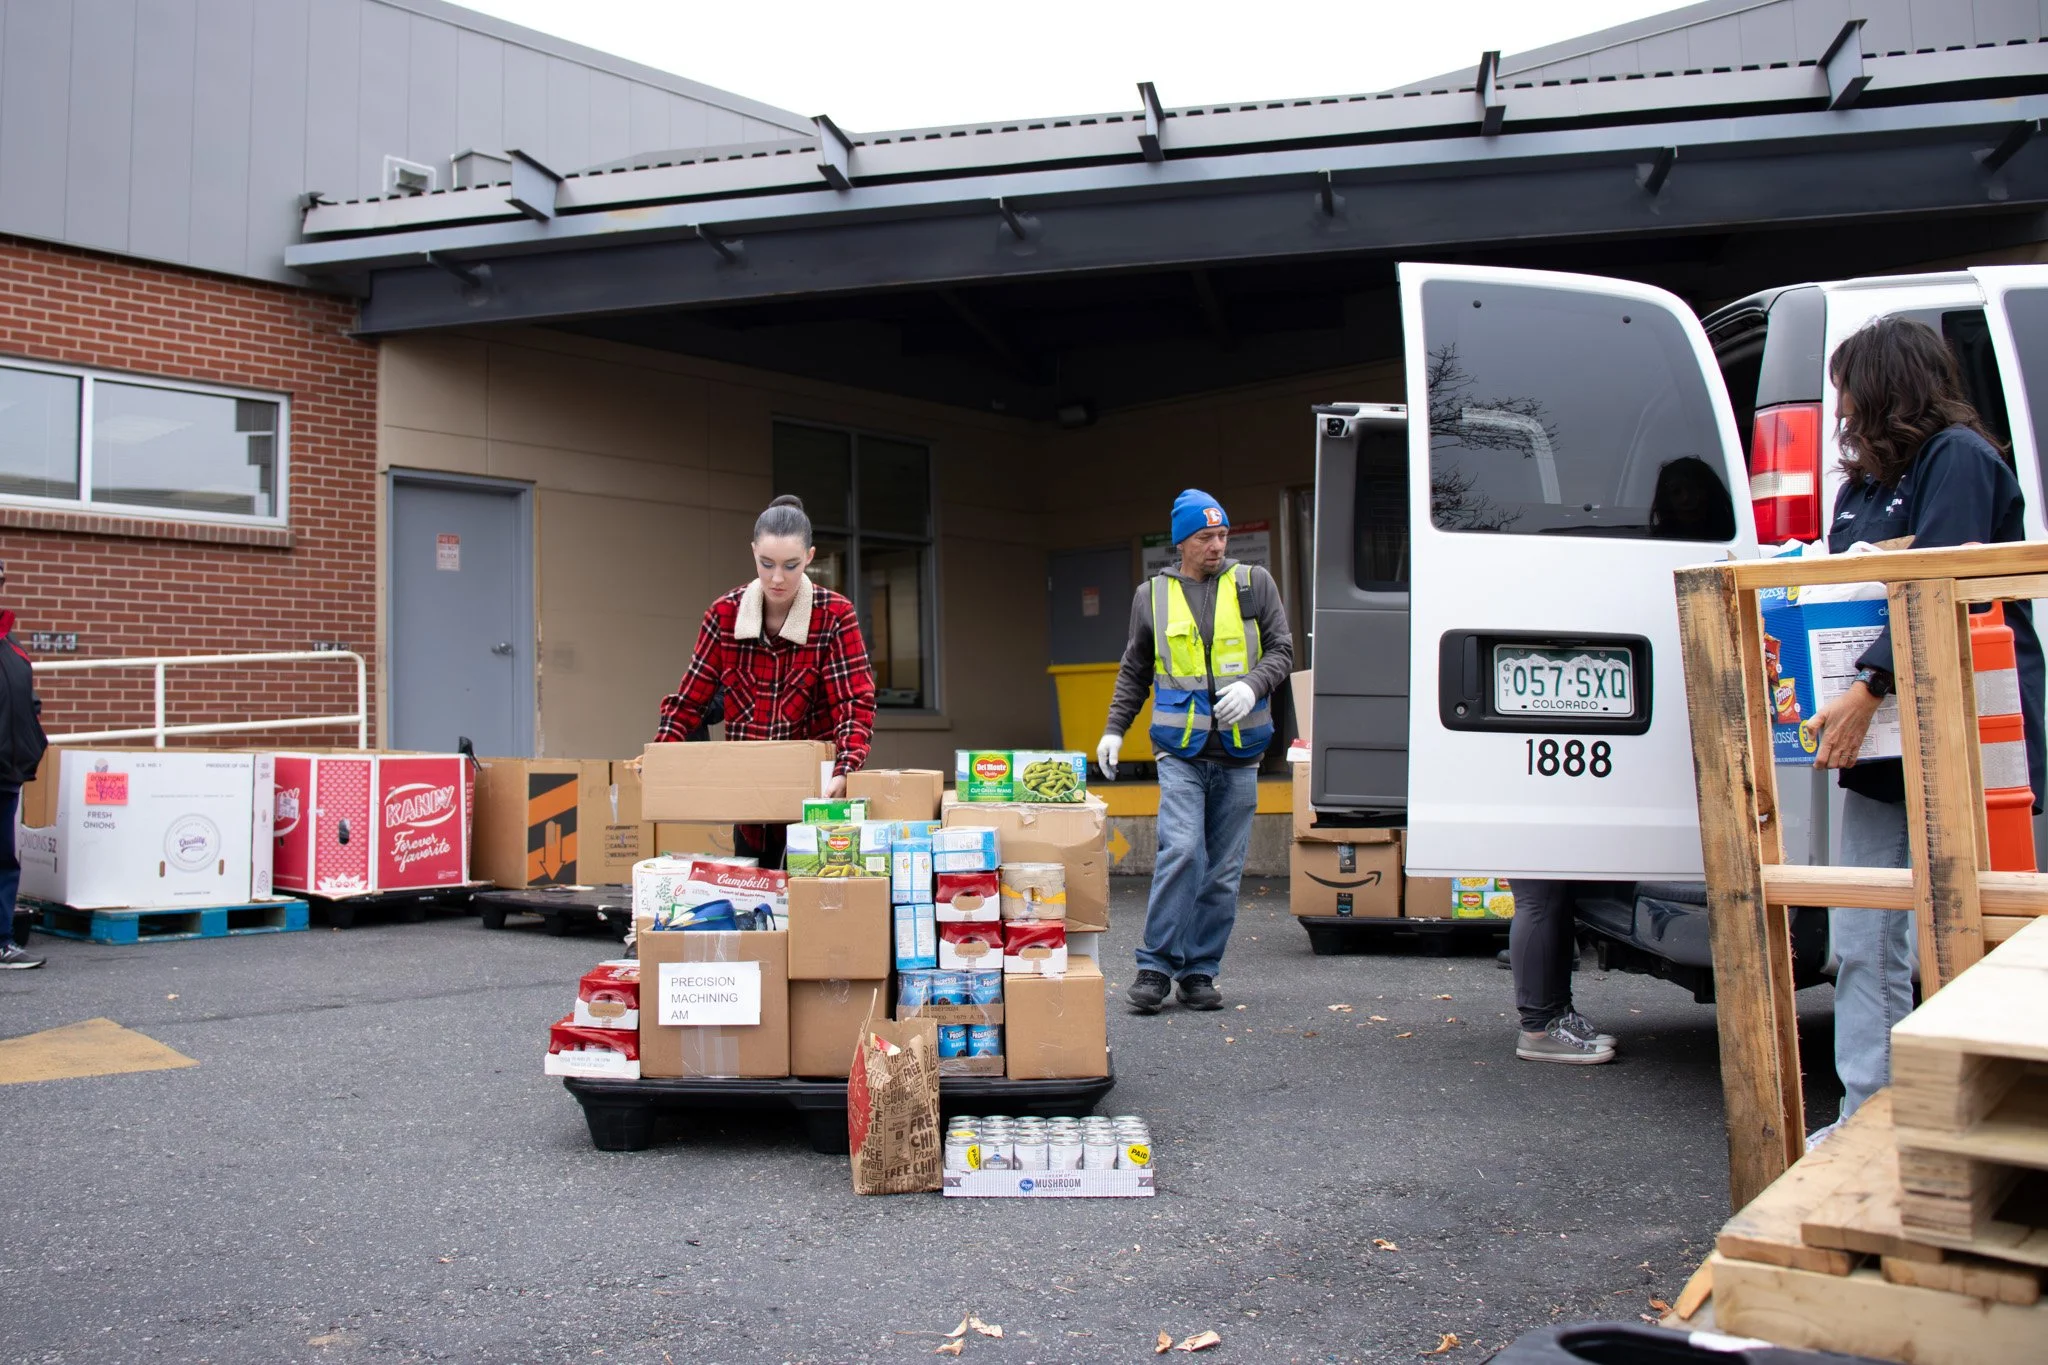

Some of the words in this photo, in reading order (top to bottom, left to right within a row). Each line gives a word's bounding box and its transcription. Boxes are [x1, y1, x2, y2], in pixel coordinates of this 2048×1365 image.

[1532, 700, 1598, 710] COLORADO
[1526, 738, 1612, 778] 1888
[987, 763, 1006, 771] Monte
[87, 811, 112, 819] FRESH
[83, 821, 115, 830] ONIONS
[391, 829, 438, 855] Forever
[399, 838, 450, 873] favorite
[717, 872, 770, 889] Campbell's
[671, 976, 736, 987] PRECISION
[671, 993, 739, 1003] MACHINING
[671, 1010, 688, 1020] AM
[903, 1062, 921, 1082] FREE
[1131, 1148, 1149, 1160] PAID
[885, 1163, 911, 1179] FREE
[1035, 1178, 1081, 1188] MUSHROOM
